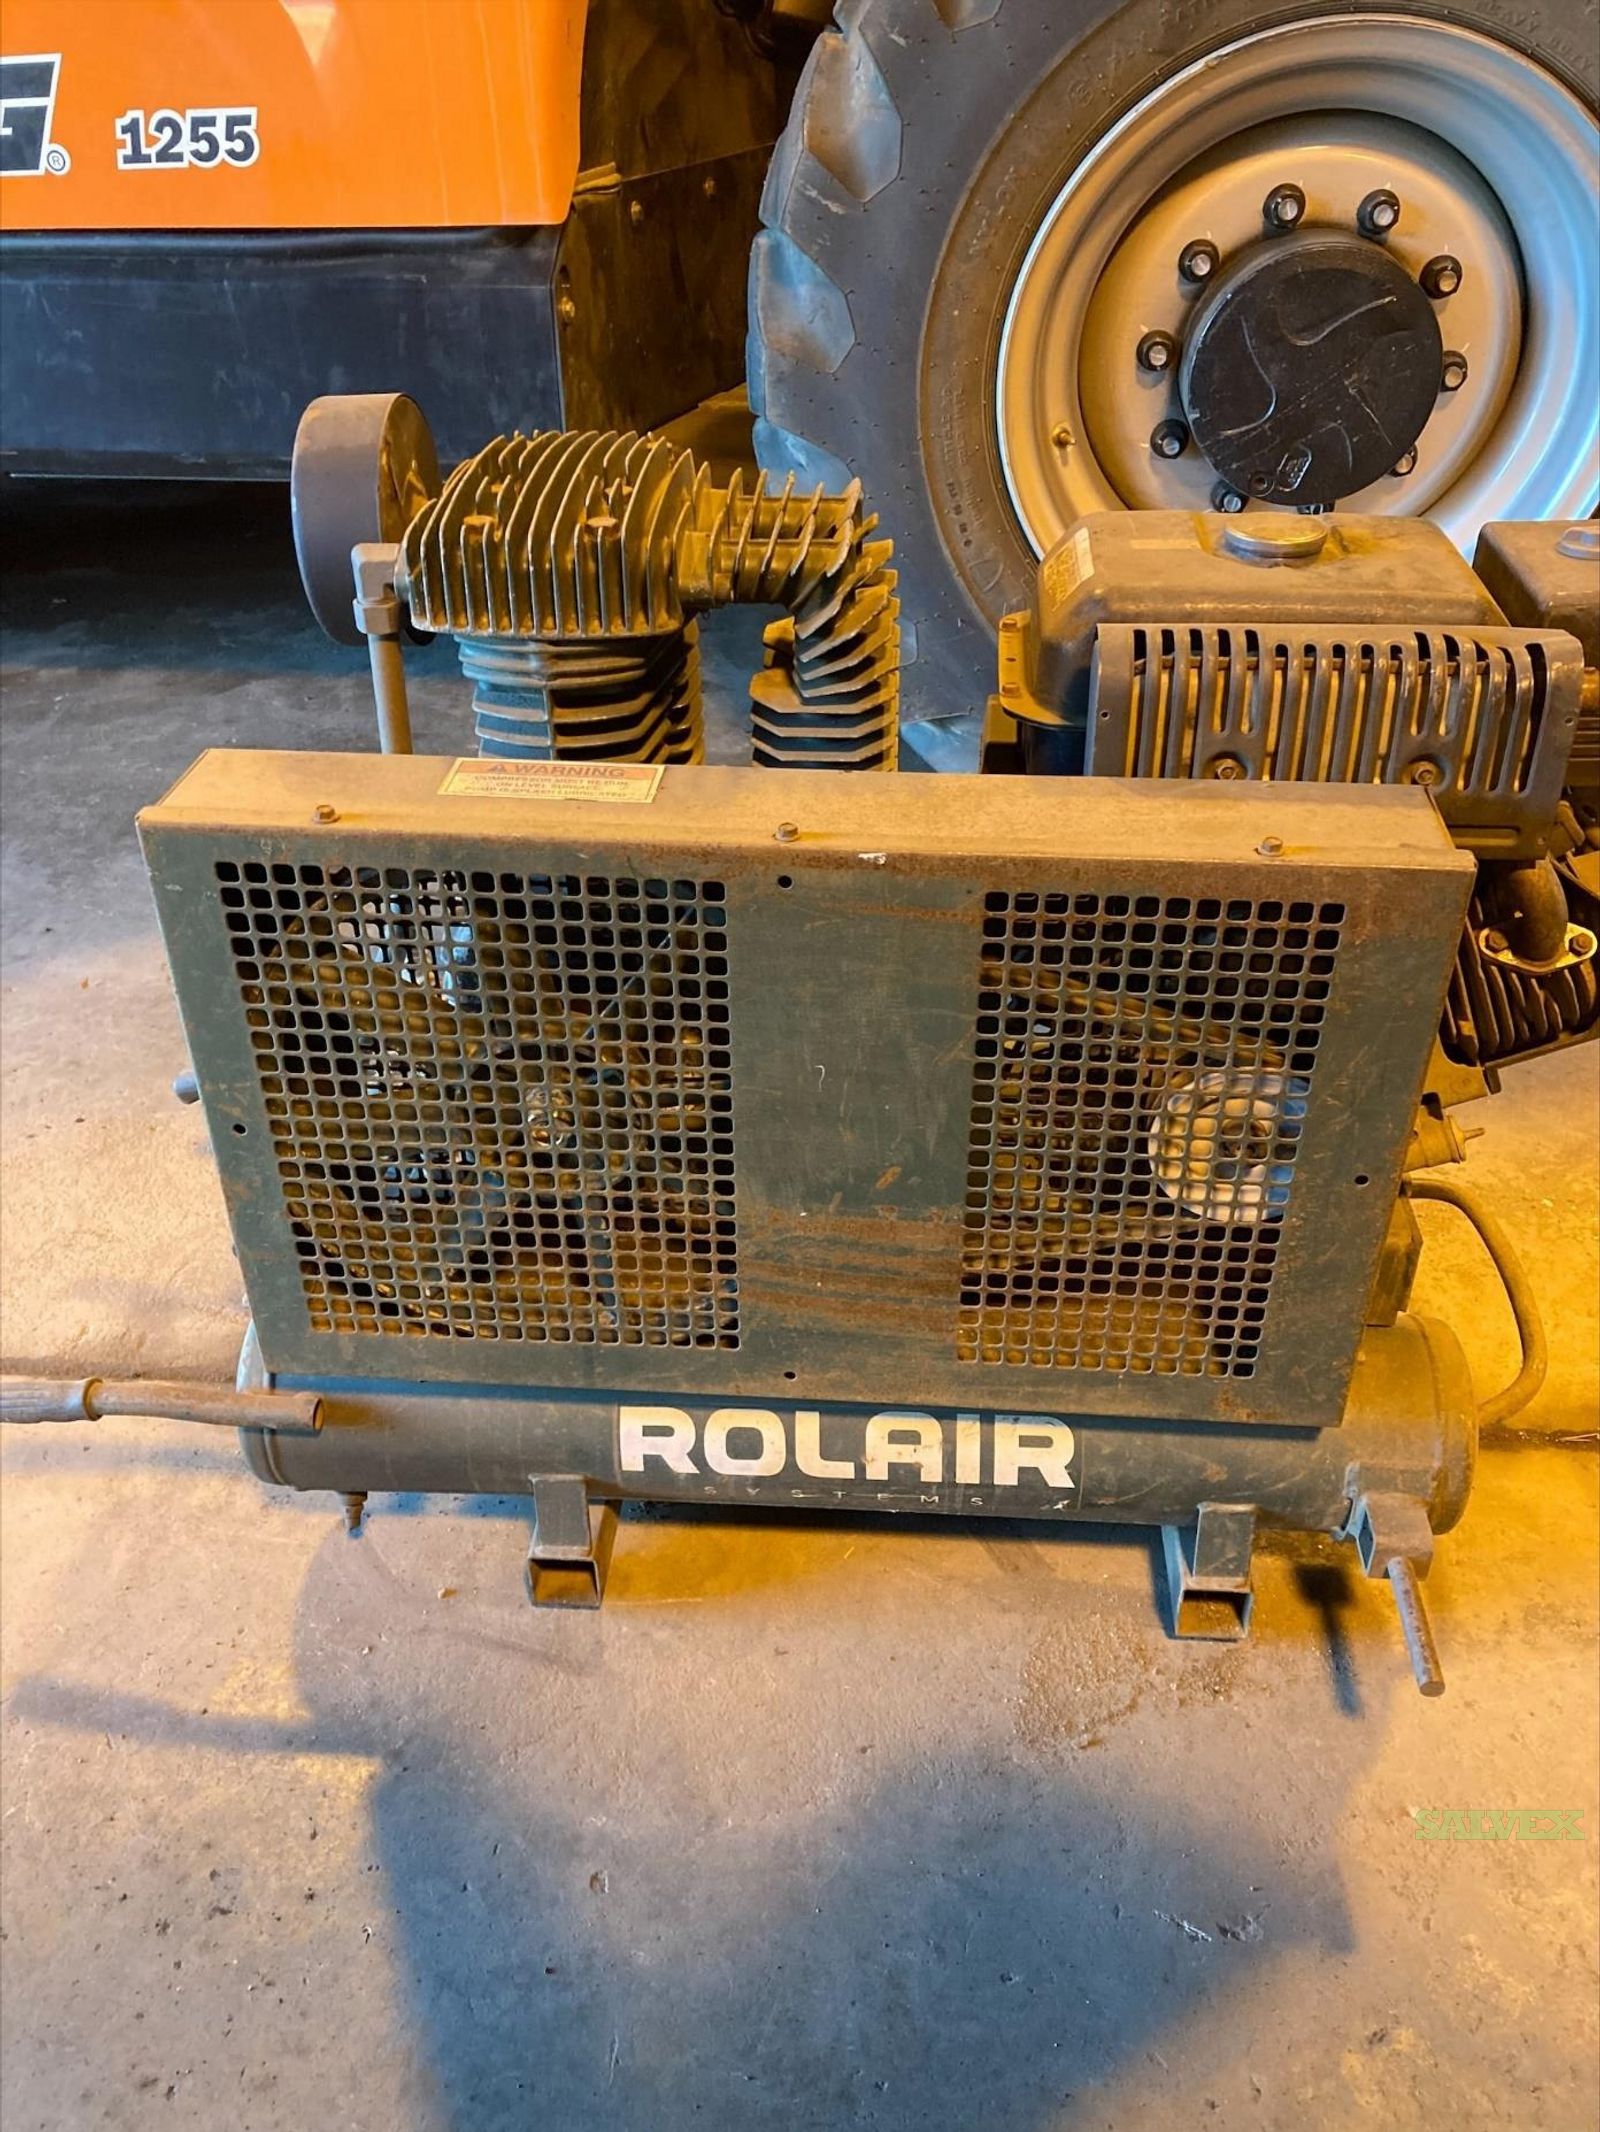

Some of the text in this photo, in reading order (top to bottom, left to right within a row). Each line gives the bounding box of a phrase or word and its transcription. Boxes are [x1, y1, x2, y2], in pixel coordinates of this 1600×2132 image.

[117, 110, 258, 167] 1255
[514, 763, 626, 778] WARNING
[618, 1405, 1076, 1489] ROLAIR
